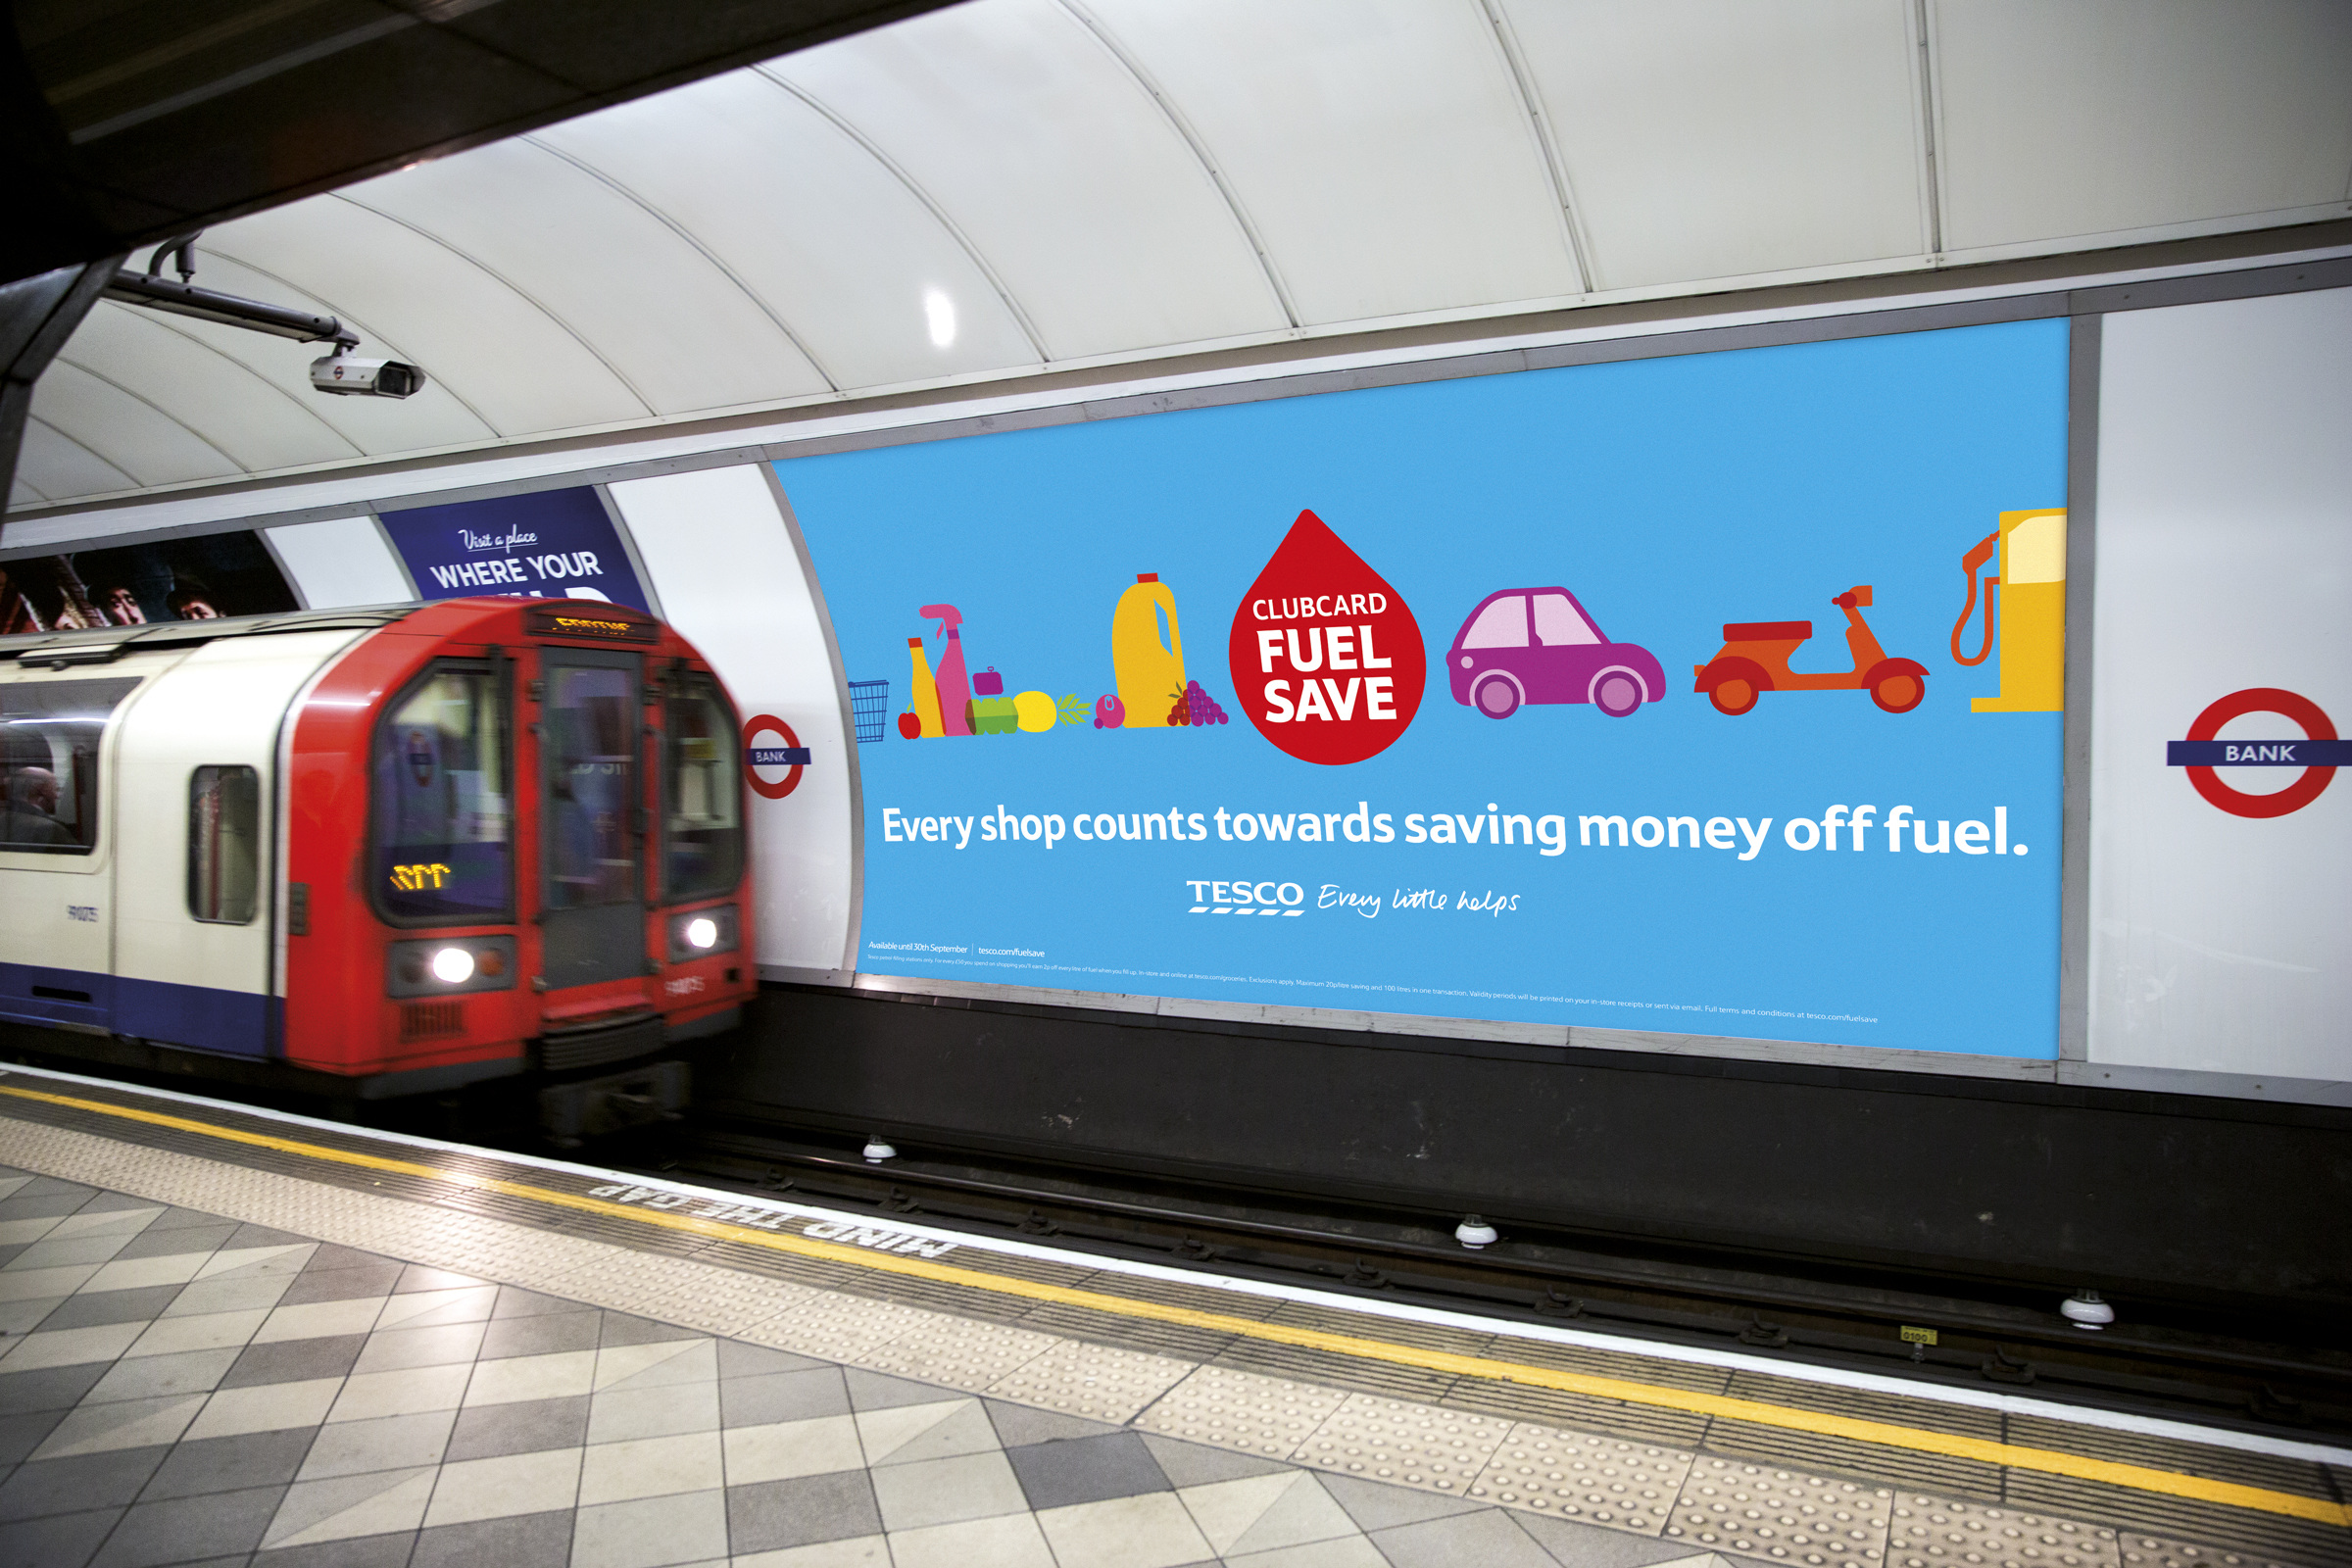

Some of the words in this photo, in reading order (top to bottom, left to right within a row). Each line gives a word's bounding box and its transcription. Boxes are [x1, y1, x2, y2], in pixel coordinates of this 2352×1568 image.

[458, 529, 492, 550] Visit
[495, 536, 504, 546] a
[505, 523, 538, 554] place
[429, 558, 528, 589] WHERE
[525, 551, 604, 580] YOUR
[1252, 593, 1387, 620] CLUBCARD
[1256, 625, 1393, 673] FUEL
[1264, 676, 1397, 723] SAVE
[755, 751, 786, 762] BANK
[2226, 745, 2296, 761] BANK
[883, 808, 974, 850] Every
[981, 805, 1065, 849] shop
[1073, 808, 1207, 840] counts
[1214, 802, 1395, 843] towards
[1405, 804, 1566, 856] saving
[1579, 815, 1773, 860] money
[1785, 805, 1877, 851] off
[1881, 806, 2029, 856] fuel.
[1186, 880, 1304, 906] TESCO
[1317, 884, 1381, 918] Every
[1392, 888, 1447, 910] little
[1456, 890, 1521, 918] helps
[868, 941, 898, 950] Available
[930, 944, 968, 954] September
[978, 948, 1045, 957] tesco.com/fuelsave
[1806, 1013, 1878, 1023] tesco.com/fuelsave
[588, 1184, 690, 1209] GAP
[691, 1205, 797, 1229] THE
[802, 1223, 958, 1259] MIND
